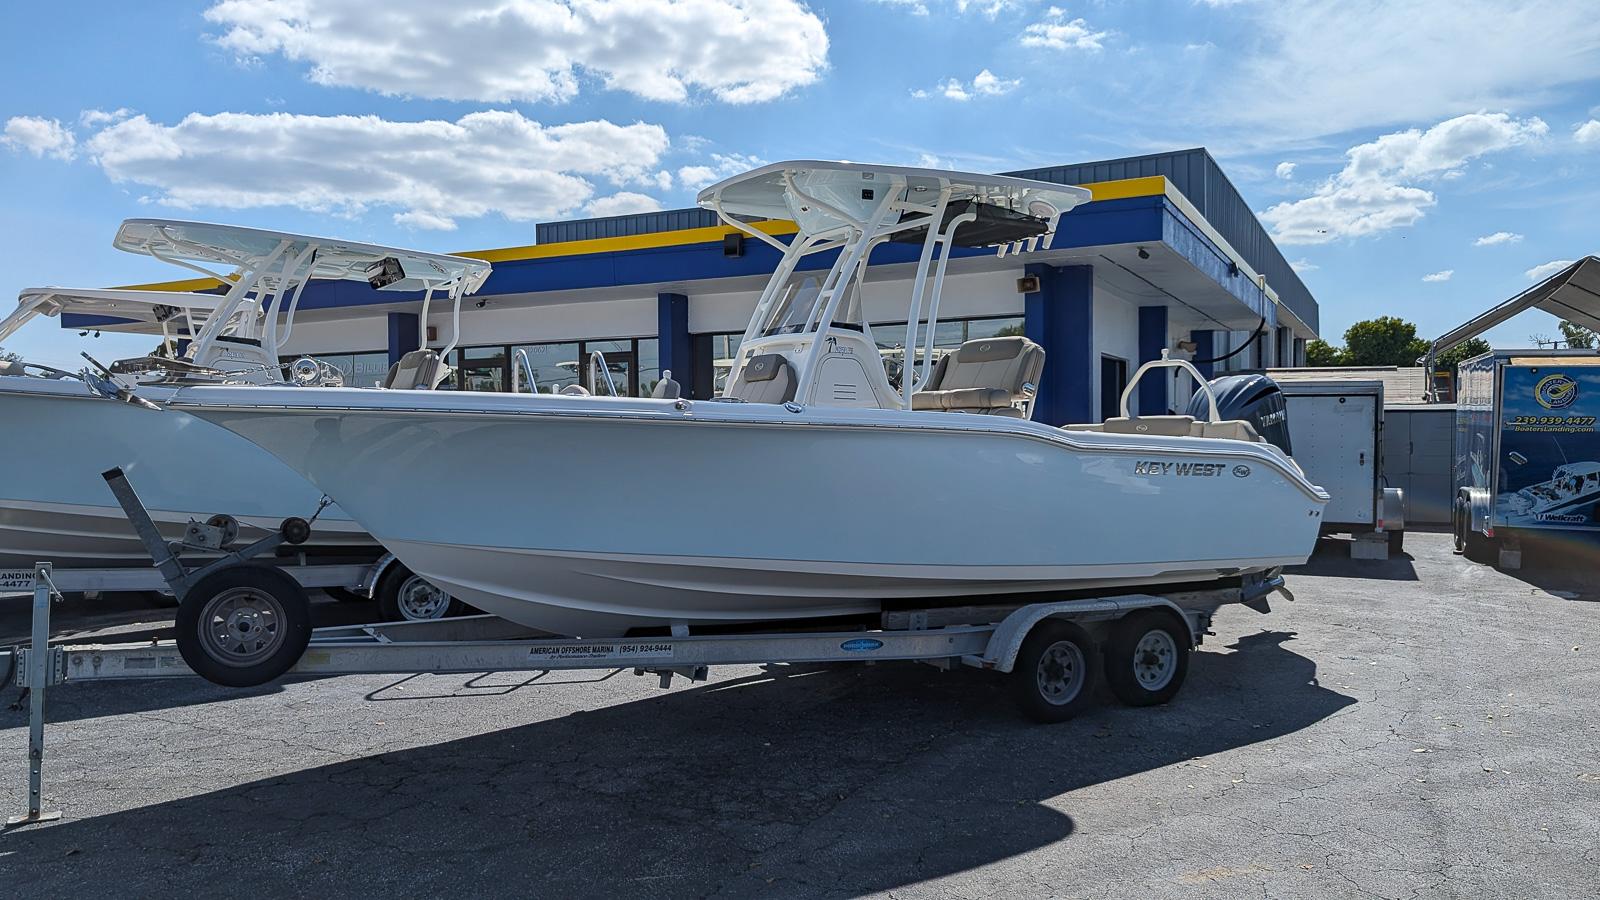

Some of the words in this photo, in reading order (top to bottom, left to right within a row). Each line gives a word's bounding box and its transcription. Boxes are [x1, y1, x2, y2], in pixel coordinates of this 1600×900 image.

[1515, 416, 1596, 425] 239.939.4477
[1135, 461, 1173, 475] KEY
[1176, 463, 1226, 476] WEST
[0, 572, 36, 580] ANDIN
[530, 647, 559, 655] AMERICAN
[561, 646, 592, 654] OFFSHORE
[619, 645, 637, 653] (954)
[640, 644, 672, 653] 924-9444
